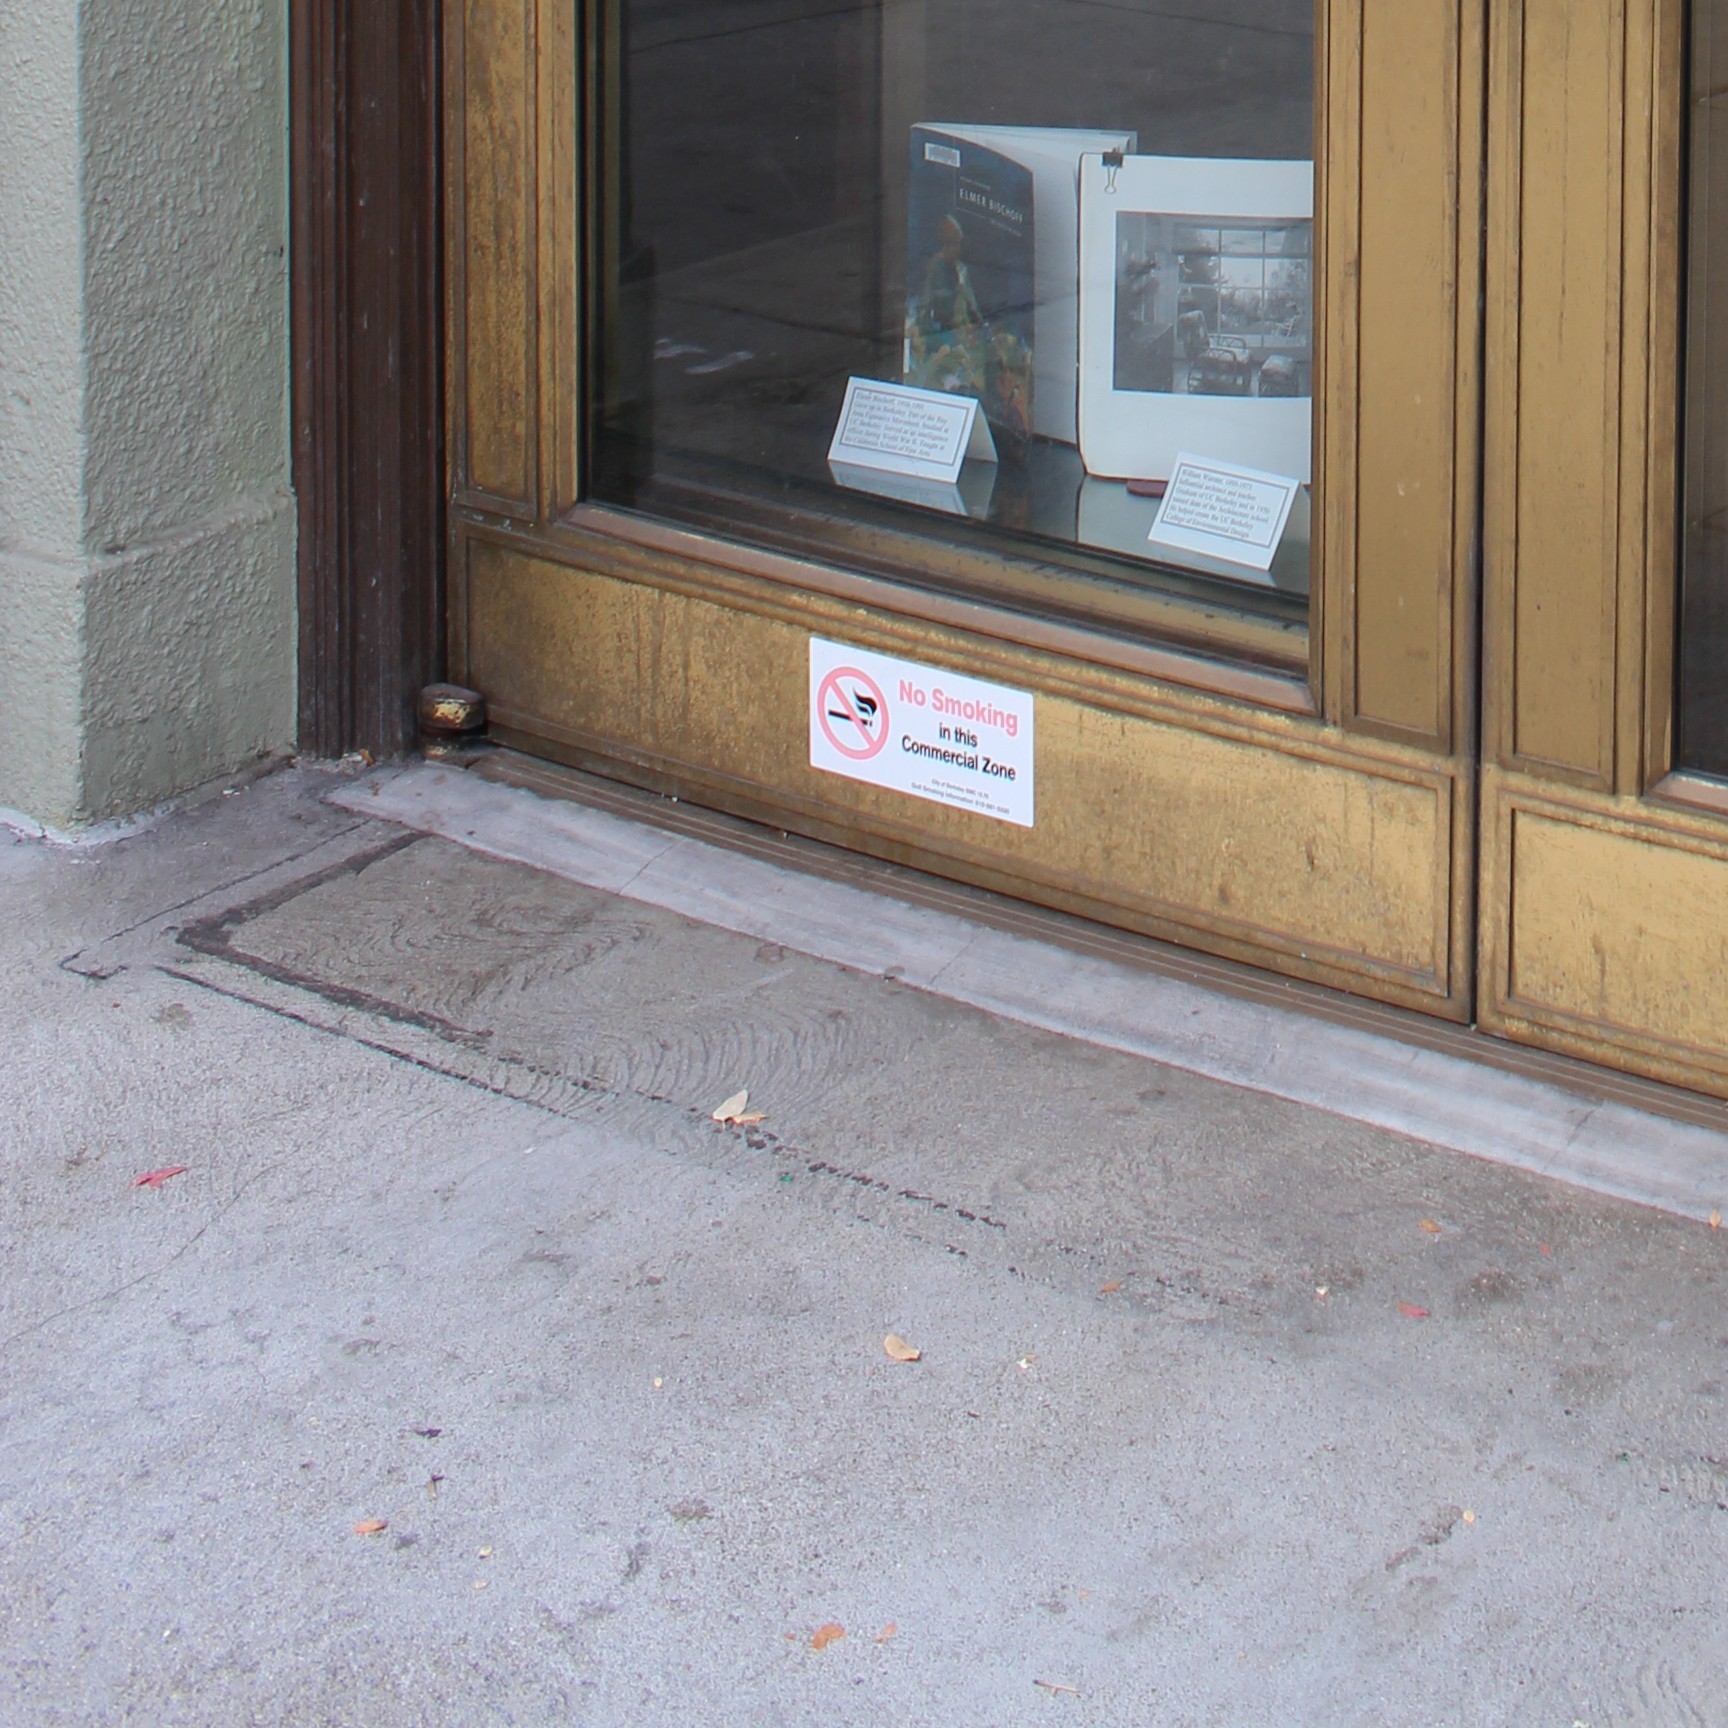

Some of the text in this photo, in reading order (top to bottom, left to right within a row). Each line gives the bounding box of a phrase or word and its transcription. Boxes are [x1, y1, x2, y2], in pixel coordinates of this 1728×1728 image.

[960, 188, 986, 208] ELMER
[899, 679, 1018, 737] No Smoking
[939, 722, 978, 747] in this
[902, 735, 1016, 781] Commercial Zone
